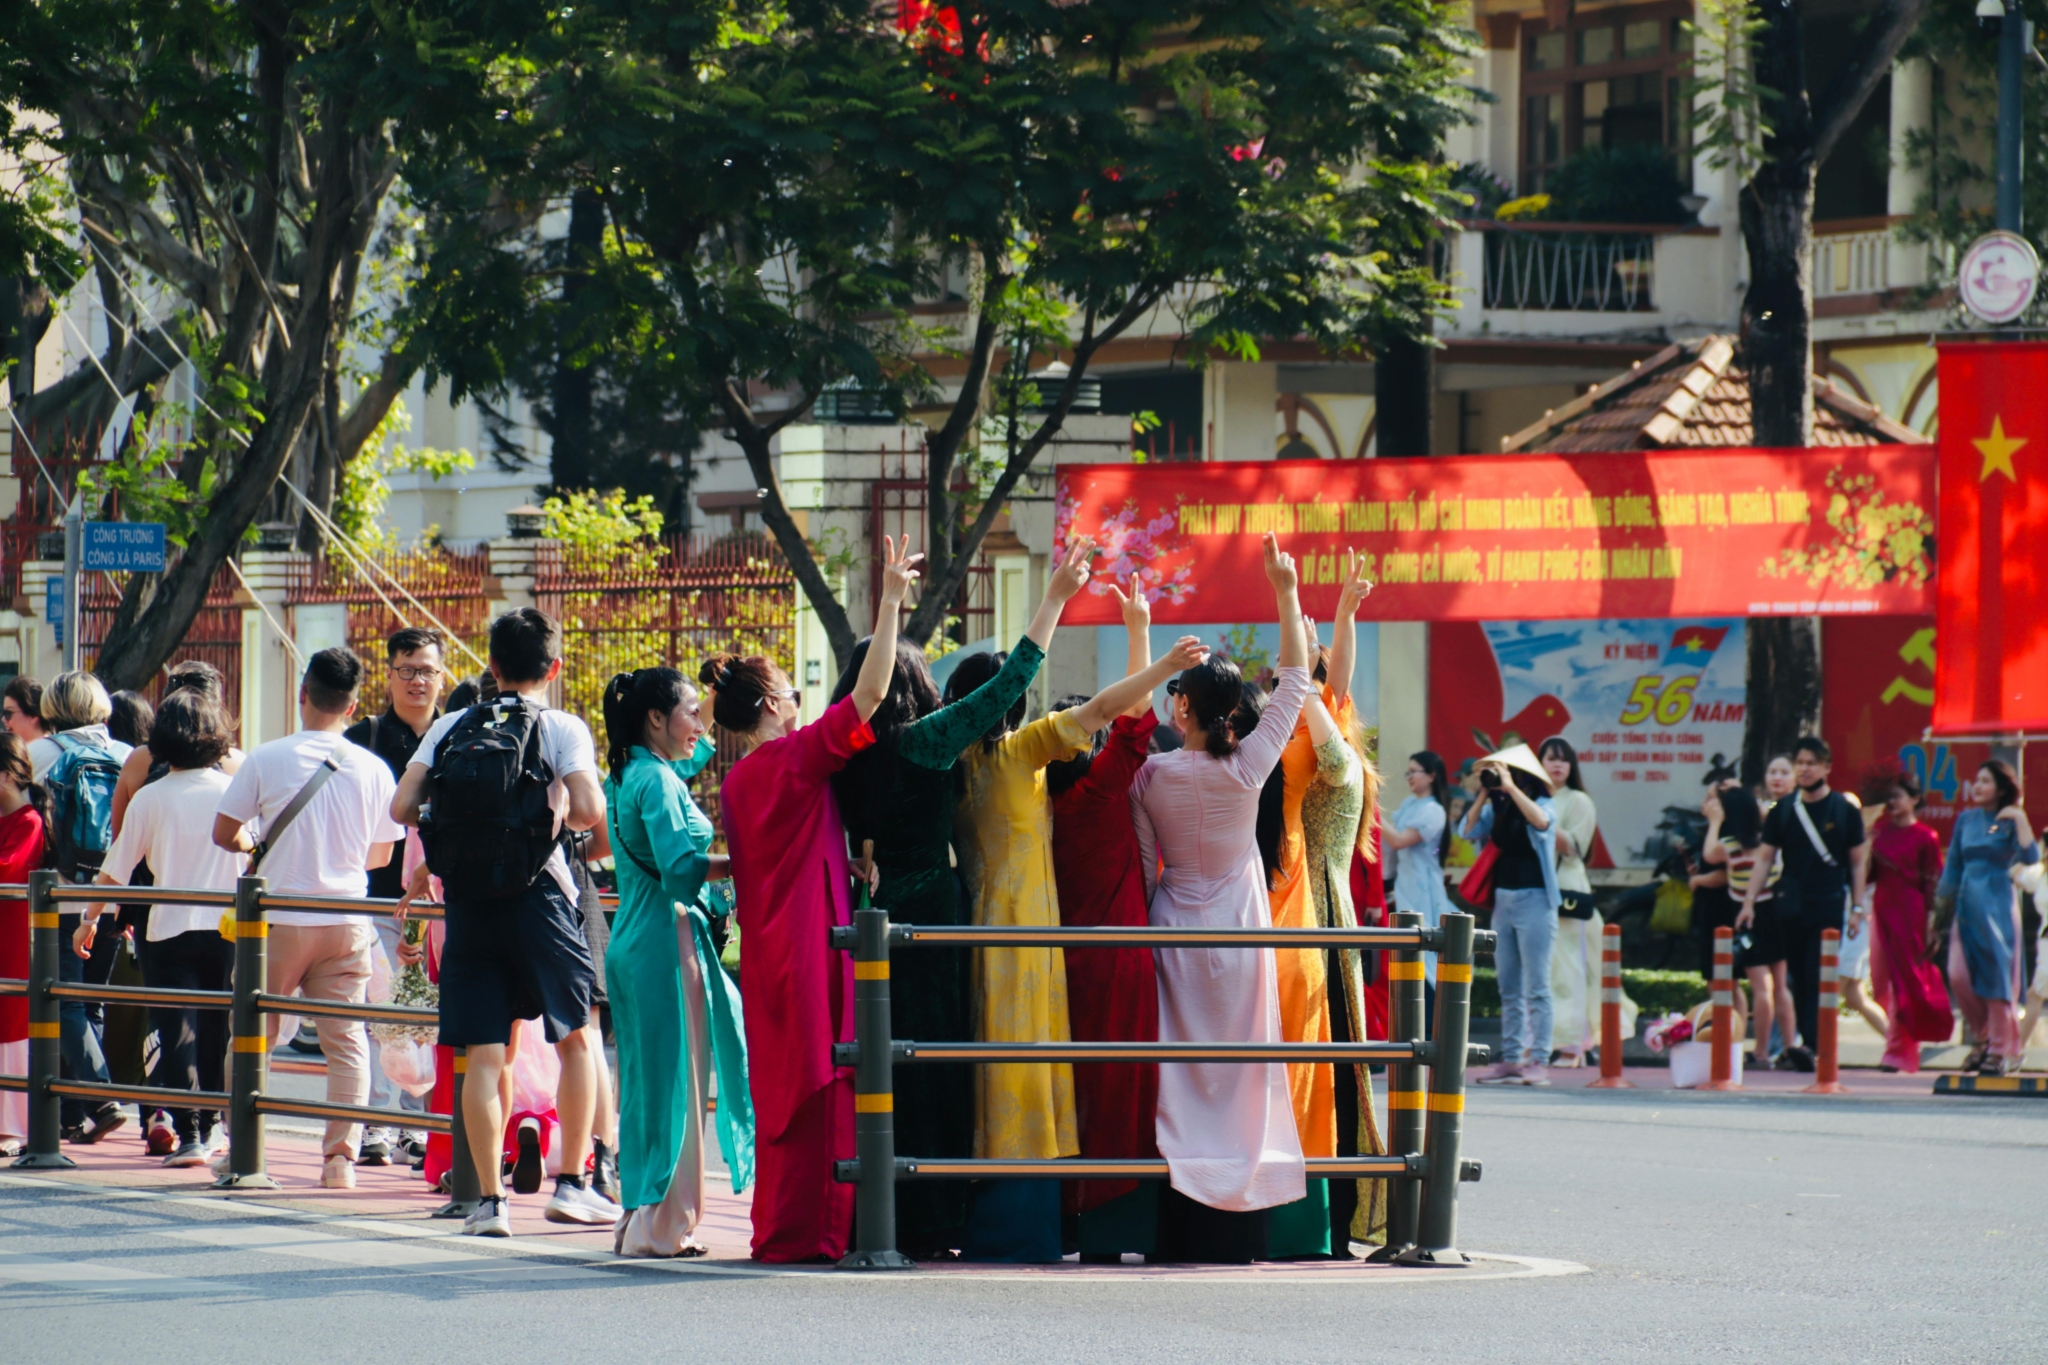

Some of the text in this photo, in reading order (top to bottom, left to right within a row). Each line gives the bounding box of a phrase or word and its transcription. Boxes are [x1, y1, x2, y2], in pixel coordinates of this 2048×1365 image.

[1179, 498, 1212, 535] PHÁT
[1216, 504, 1241, 534] HUY
[1297, 491, 1340, 533] THỐNG
[1342, 495, 1386, 532] THÀNH
[1389, 490, 1416, 532] PHỐ
[1440, 492, 1463, 531] CHÍ
[1465, 498, 1502, 531] MINH
[93, 526, 117, 543] CÔNG
[87, 548, 115, 565] CÔNG
[132, 552, 162, 566] PARIS
[1302, 548, 1316, 585] VÌ
[1619, 675, 1745, 727] 56 NĂM
